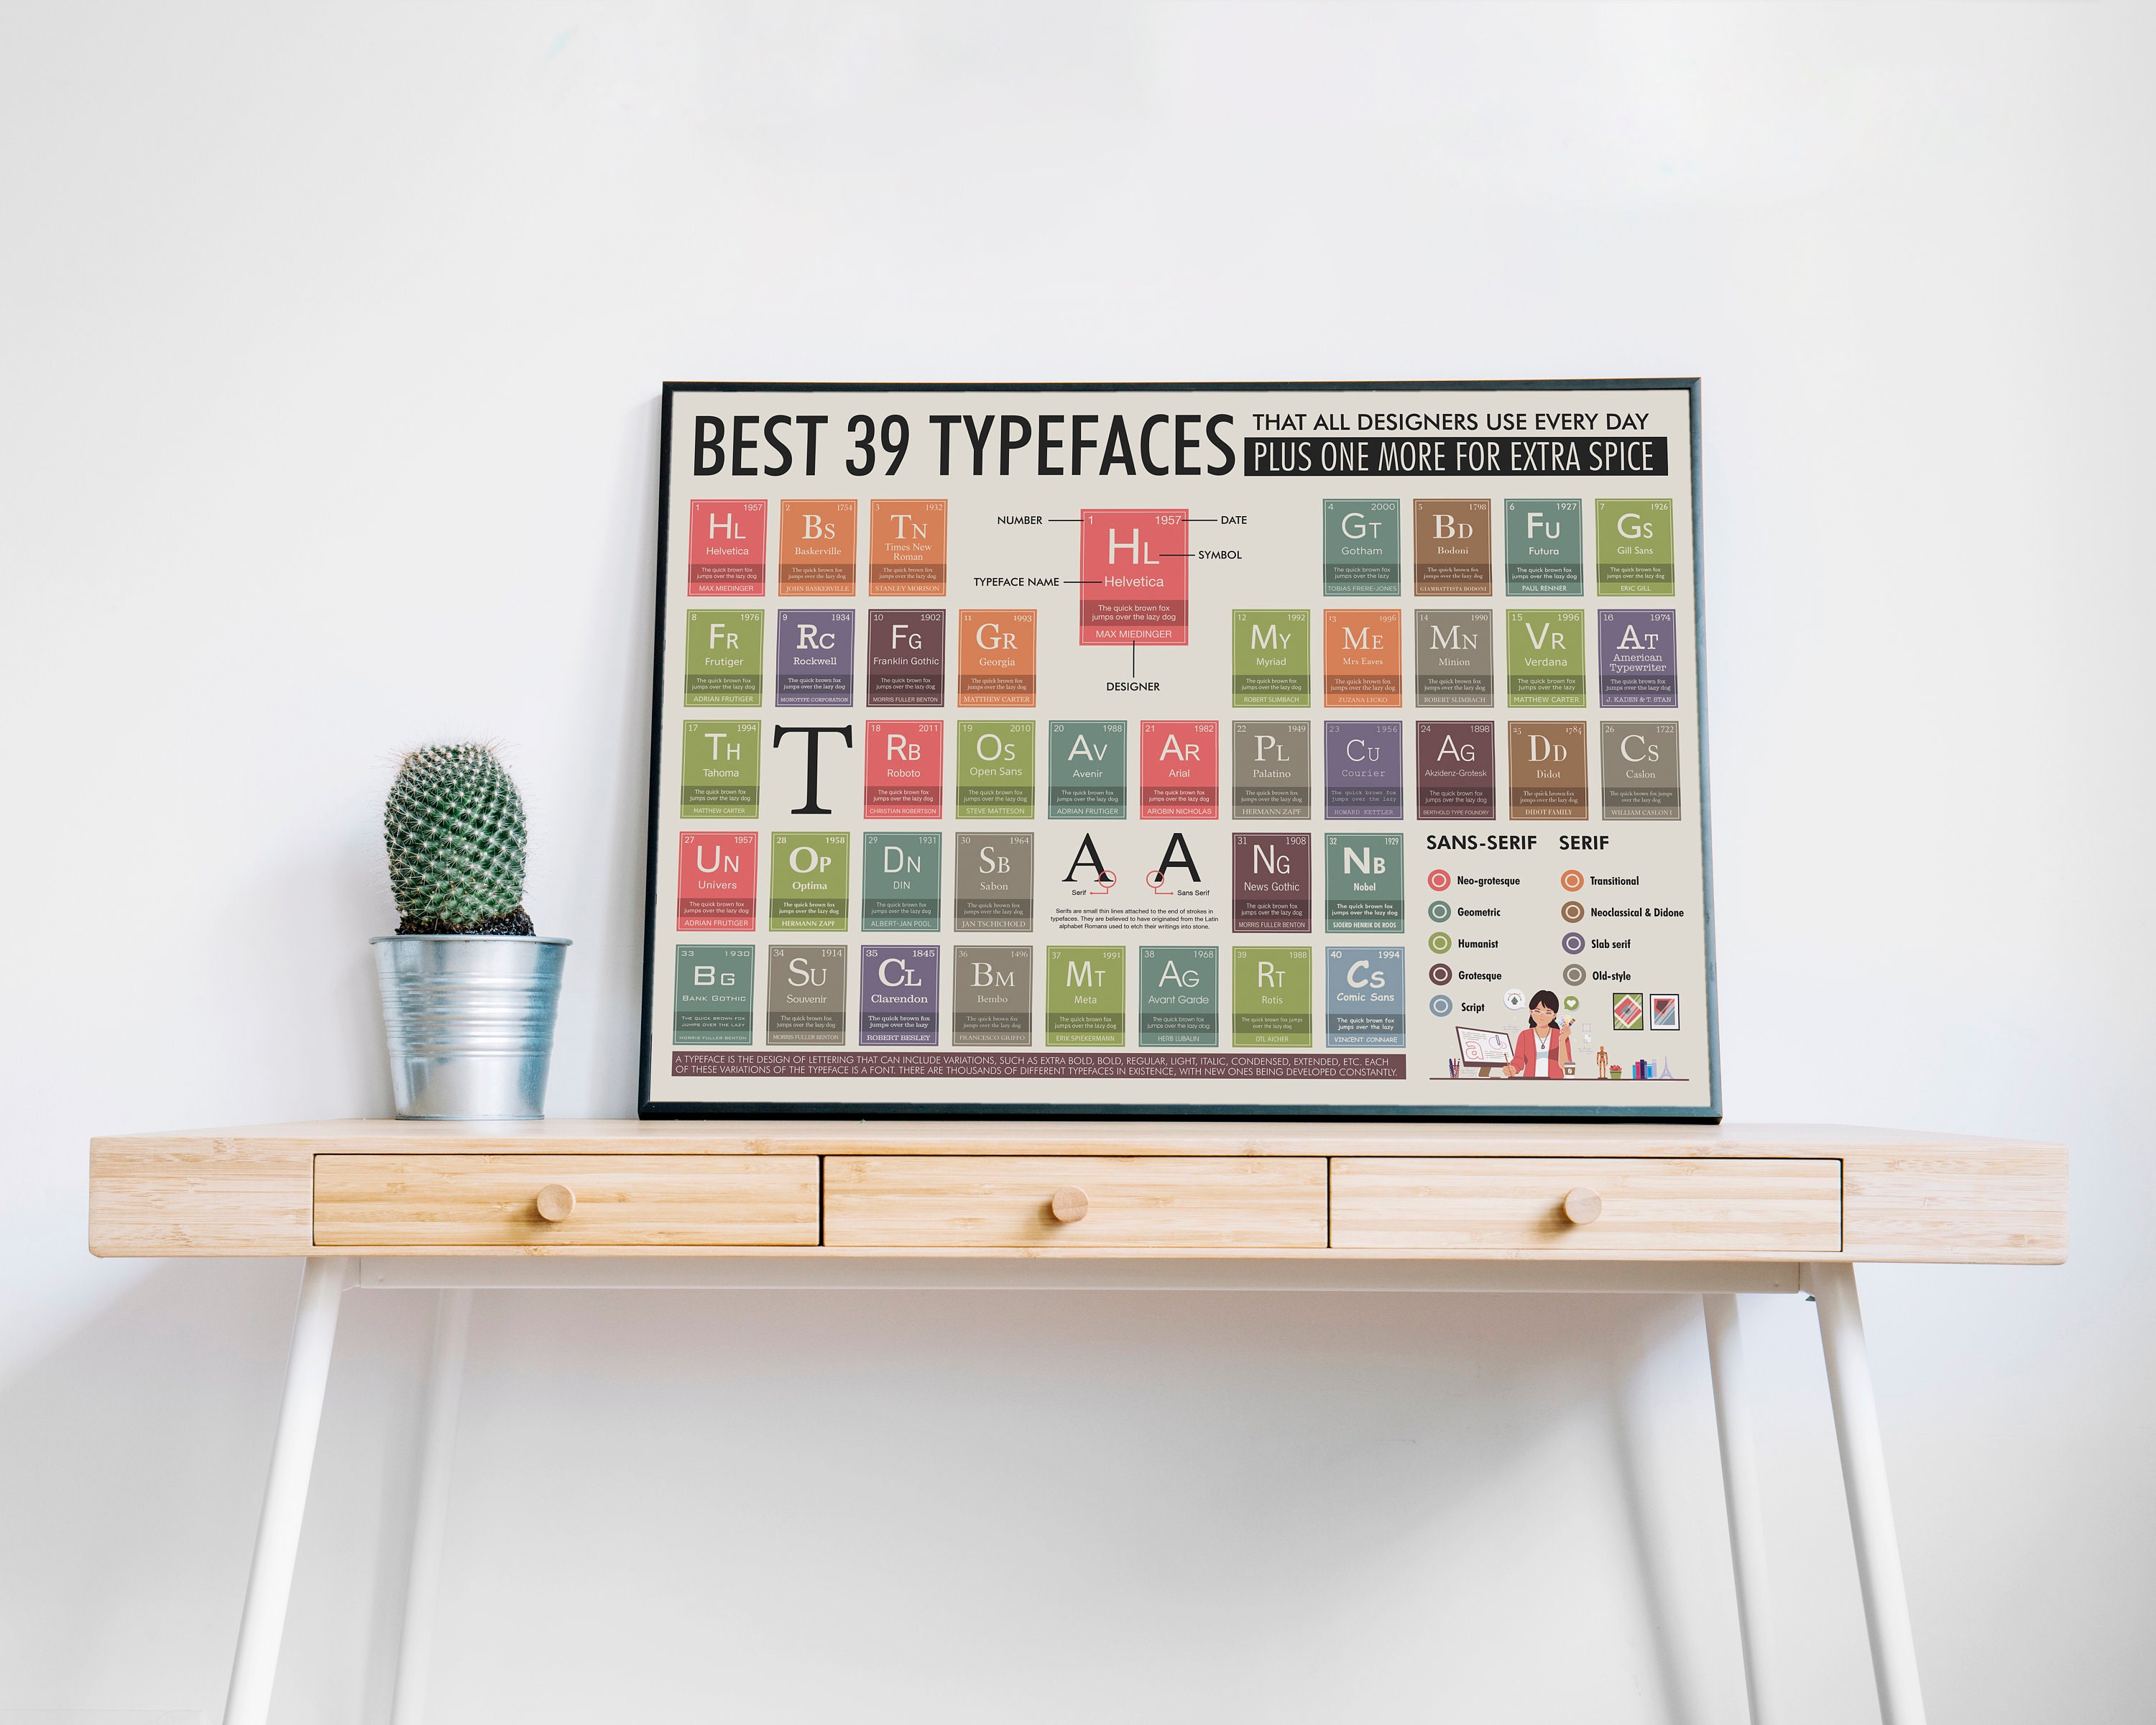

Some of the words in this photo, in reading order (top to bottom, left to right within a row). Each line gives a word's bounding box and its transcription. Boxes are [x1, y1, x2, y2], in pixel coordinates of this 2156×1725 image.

[1253, 414, 1307, 430] THAT
[1313, 414, 1350, 430] ALL
[1358, 413, 1478, 431] DESIGNERS
[1487, 413, 1527, 430] USE
[1536, 413, 1599, 430] EVERY
[1607, 413, 1649, 430] DAY
[694, 415, 828, 476] BEST
[846, 415, 909, 476] 39
[929, 414, 1235, 476] TYPEFACES
[1256, 442, 1311, 471] PLUS
[1322, 442, 1368, 471] ONE
[1378, 442, 1445, 471] MORE
[1457, 442, 1500, 471] FOR
[1511, 442, 1580, 470] EXTRA
[1590, 441, 1653, 471] SPICE
[1199, 551, 1243, 559] SYMBOL
[1105, 576, 1164, 586] Helvetica
[706, 658, 744, 667] Frutiger
[980, 658, 1015, 668] Georgia
[1257, 658, 1286, 667] Myriad
[1610, 664, 1667, 673] Typewriter
[773, 724, 852, 814] T
[970, 768, 997, 778] Open
[1427, 835, 1537, 850] SANS-SERIF
[1560, 836, 1609, 850] SERIF
[1457, 876, 1521, 887] Neo-grotesque
[1590, 876, 1639, 885] Transitional
[793, 881, 827, 891] Optima
[1245, 882, 1269, 891] News
[1272, 882, 1300, 891] Gothic
[1458, 908, 1501, 916] Geometric
[1591, 908, 1642, 916] Neoclassical
[1654, 908, 1685, 916] Didone
[1459, 939, 1499, 948] Humanist
[1592, 939, 1610, 948] Slab
[1613, 939, 1631, 948] serif
[1459, 971, 1502, 982] Grotesque
[1593, 971, 1631, 982] Old-style
[1337, 993, 1366, 1001] Comic
[1462, 1003, 1485, 1013] Script
[676, 1055, 682, 1064] A
[943, 1057, 997, 1066] VARIATIONS,
[1068, 1057, 1095, 1067] BOLD,
[1097, 1057, 1124, 1067] BOLD,
[1127, 1057, 1168, 1067] REGULAR,
[1171, 1057, 1198, 1067] LIGHT,
[1201, 1057, 1229, 1067] ITALIC,
[1231, 1057, 1291, 1067] CONDENSED,
[1294, 1057, 1341, 1067] EXTENDED,
